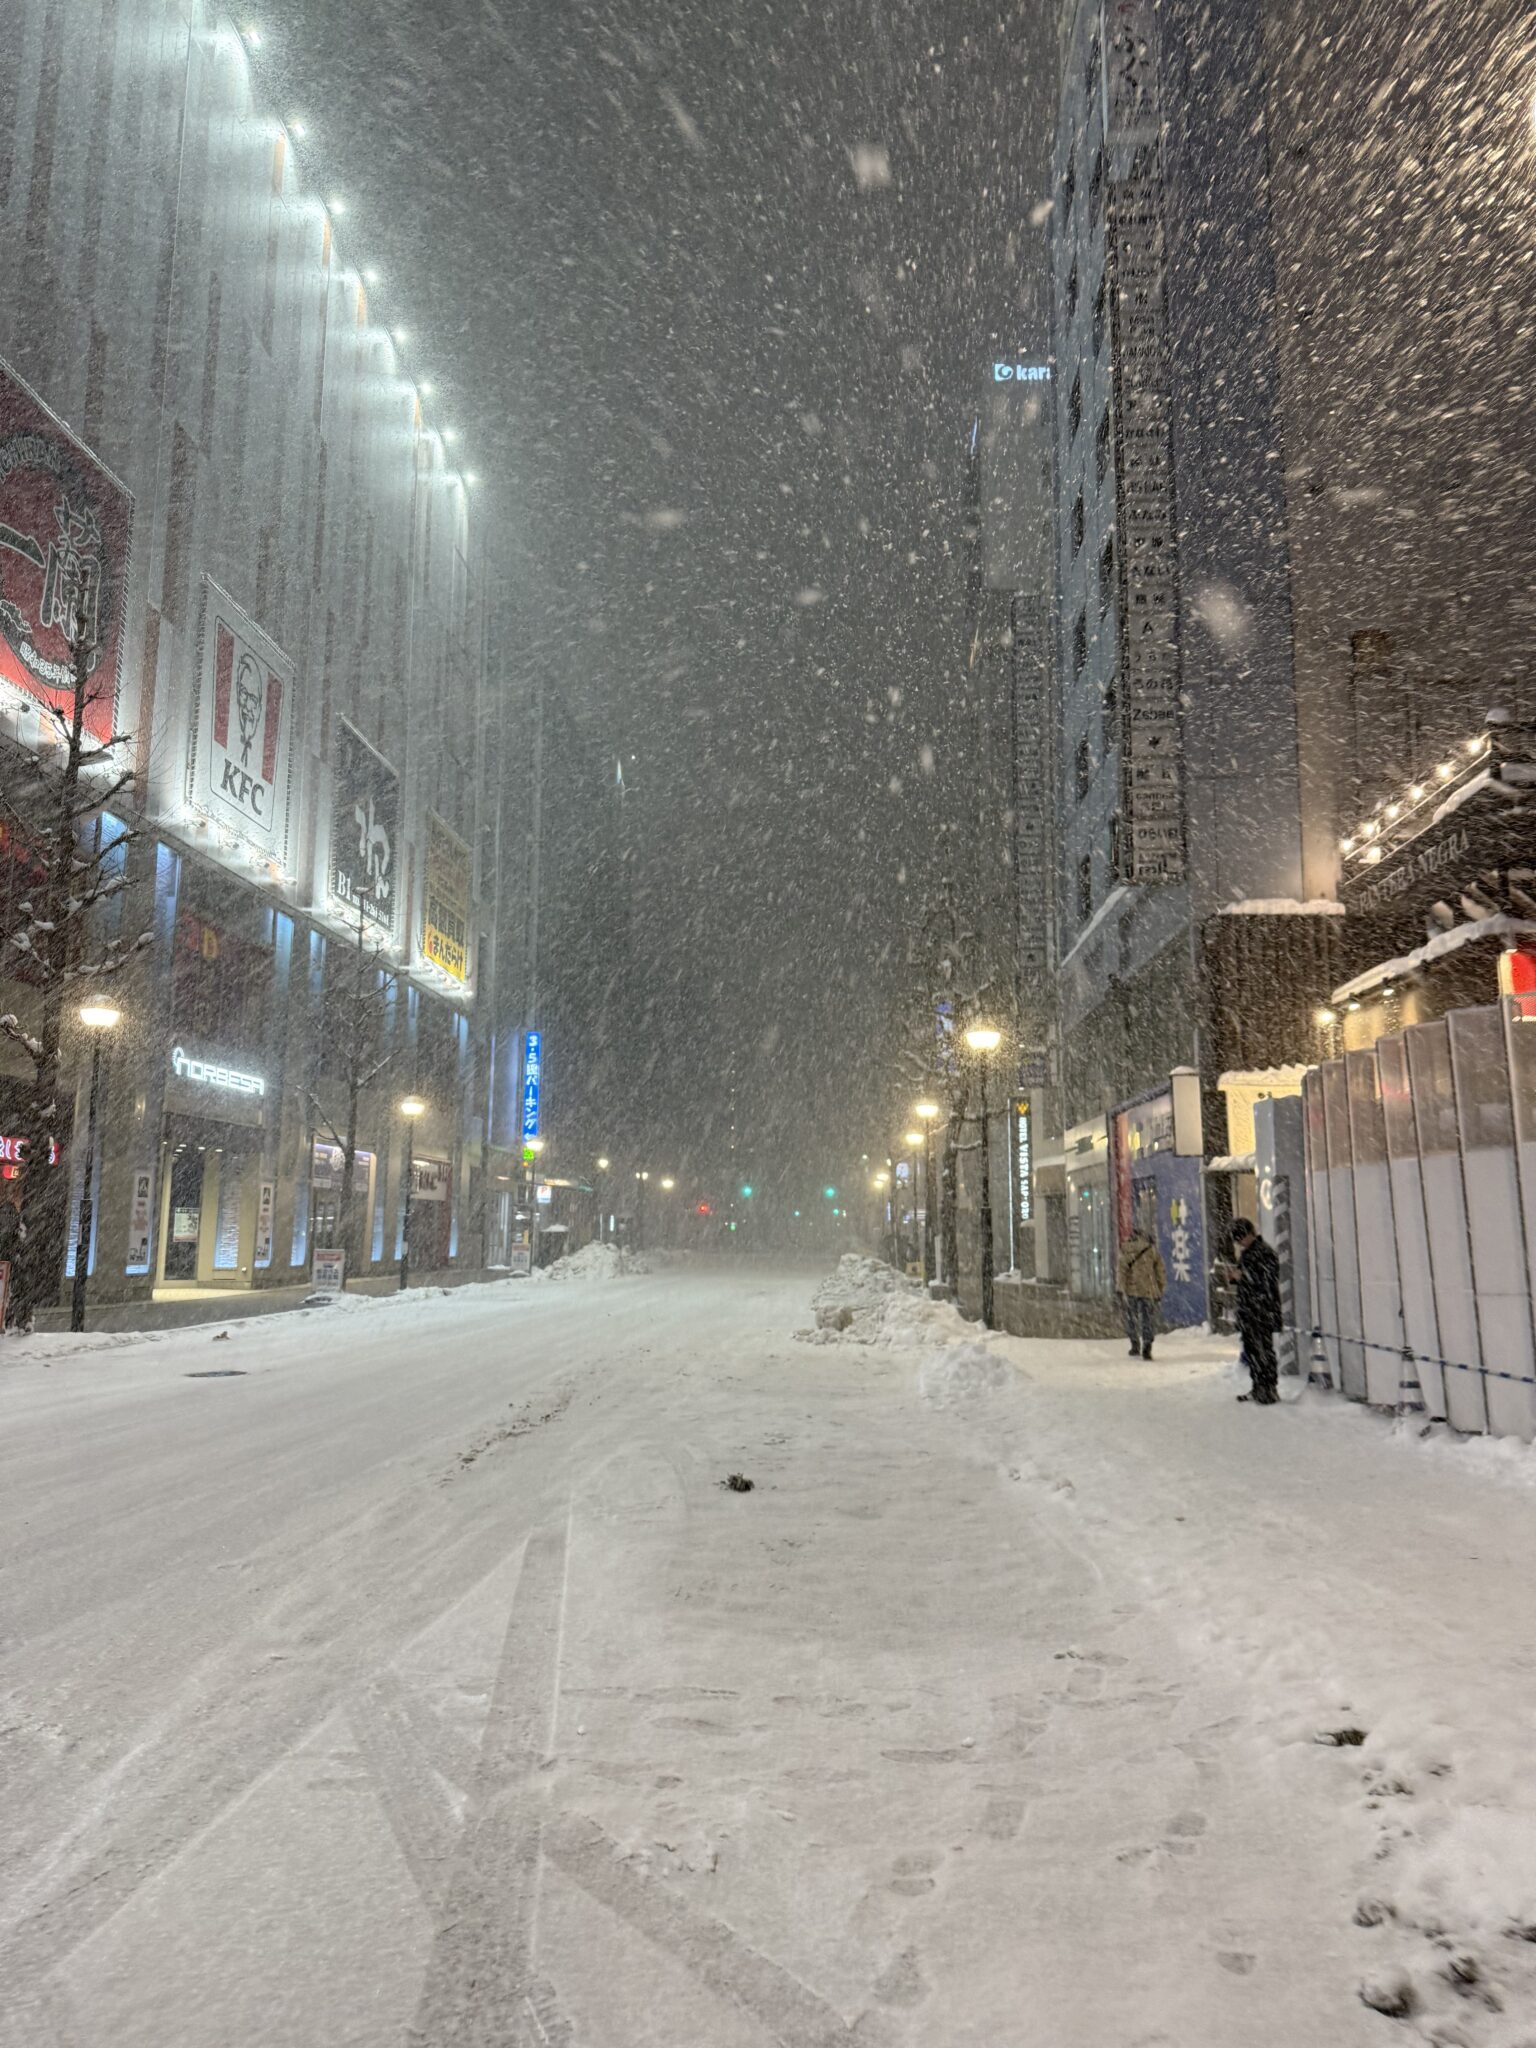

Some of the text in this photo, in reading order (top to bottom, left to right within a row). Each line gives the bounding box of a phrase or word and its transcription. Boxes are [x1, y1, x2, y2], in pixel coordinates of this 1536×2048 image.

[220, 758, 265, 816] KFC
[1018, 1143, 1029, 1178] VISTA
[1020, 1179, 1030, 1219] SAPORO
